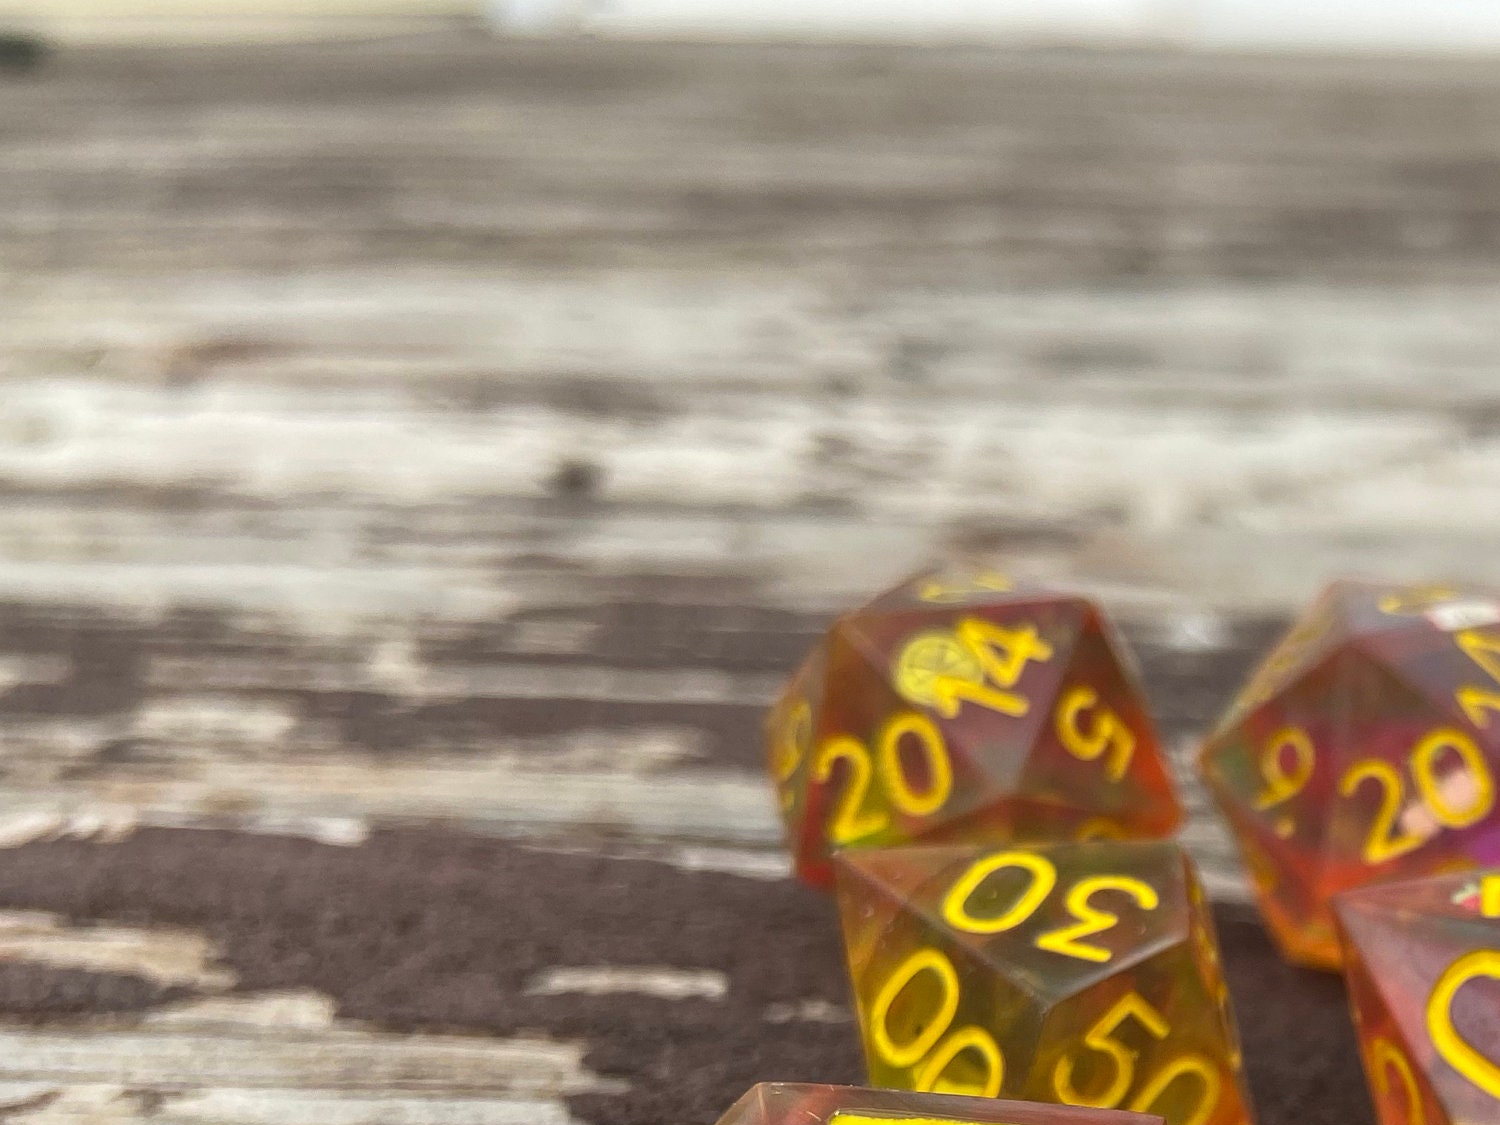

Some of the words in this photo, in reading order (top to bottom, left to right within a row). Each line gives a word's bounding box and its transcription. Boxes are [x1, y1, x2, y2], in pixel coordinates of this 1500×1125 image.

[935, 617, 1053, 718] 14
[815, 711, 952, 843] 20
[1340, 727, 1496, 864] 20
